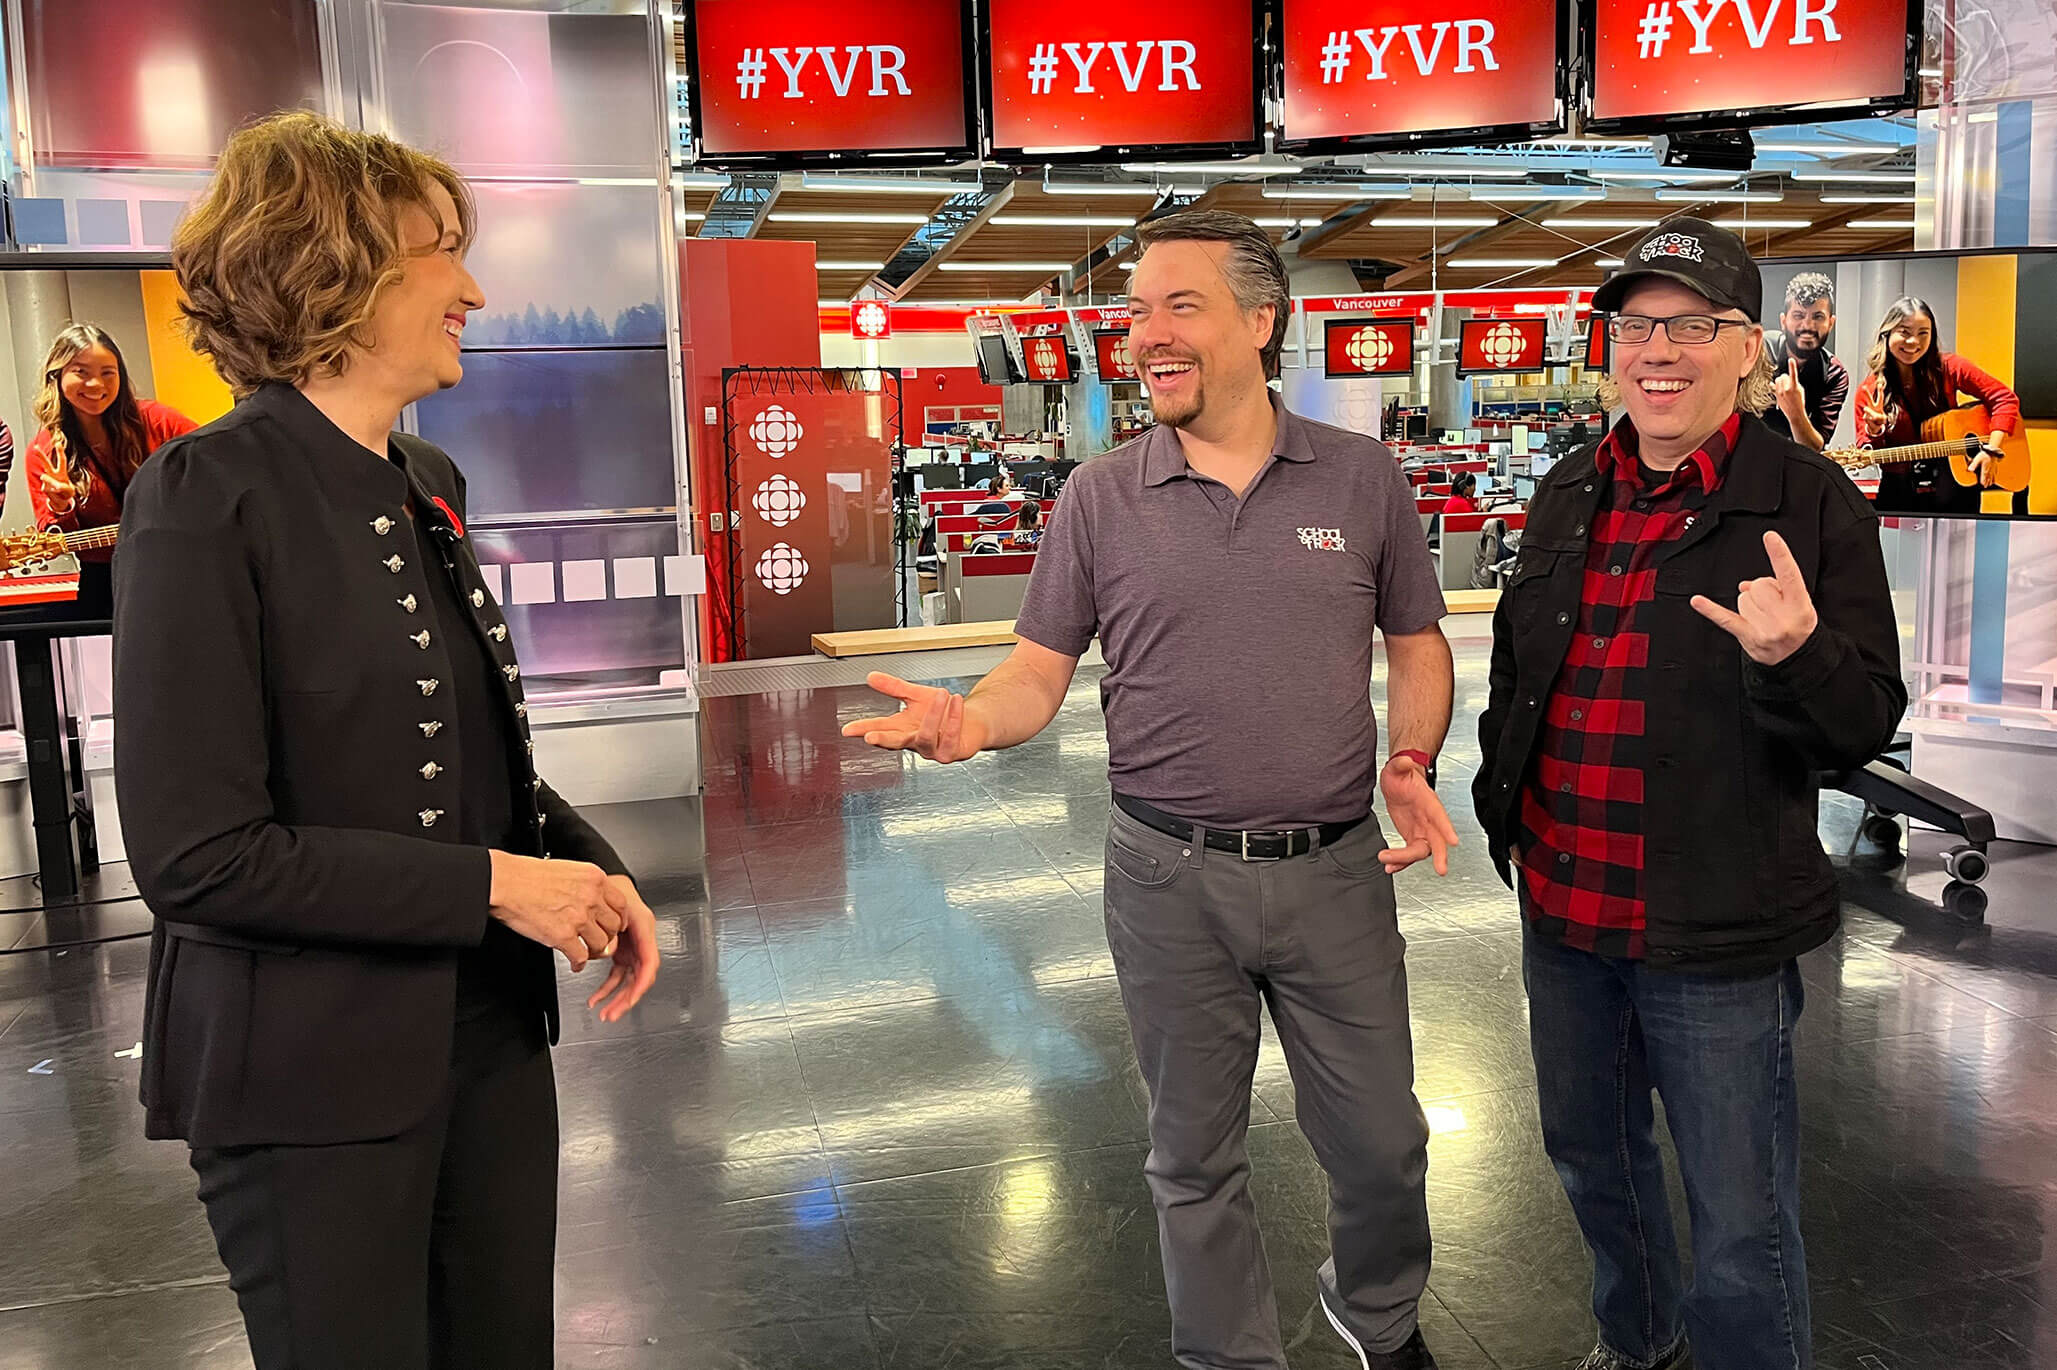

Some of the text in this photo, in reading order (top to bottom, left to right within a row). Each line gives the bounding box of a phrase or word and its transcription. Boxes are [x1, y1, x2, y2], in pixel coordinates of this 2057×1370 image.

[1319, 18, 1500, 84] #YVR
[1636, 0, 1842, 59] #YVR
[736, 45, 912, 99] #YVR
[1027, 40, 1202, 95] #YVR
[1332, 298, 1404, 310] Vancouver
[1296, 527, 1341, 541] SCHOOL
